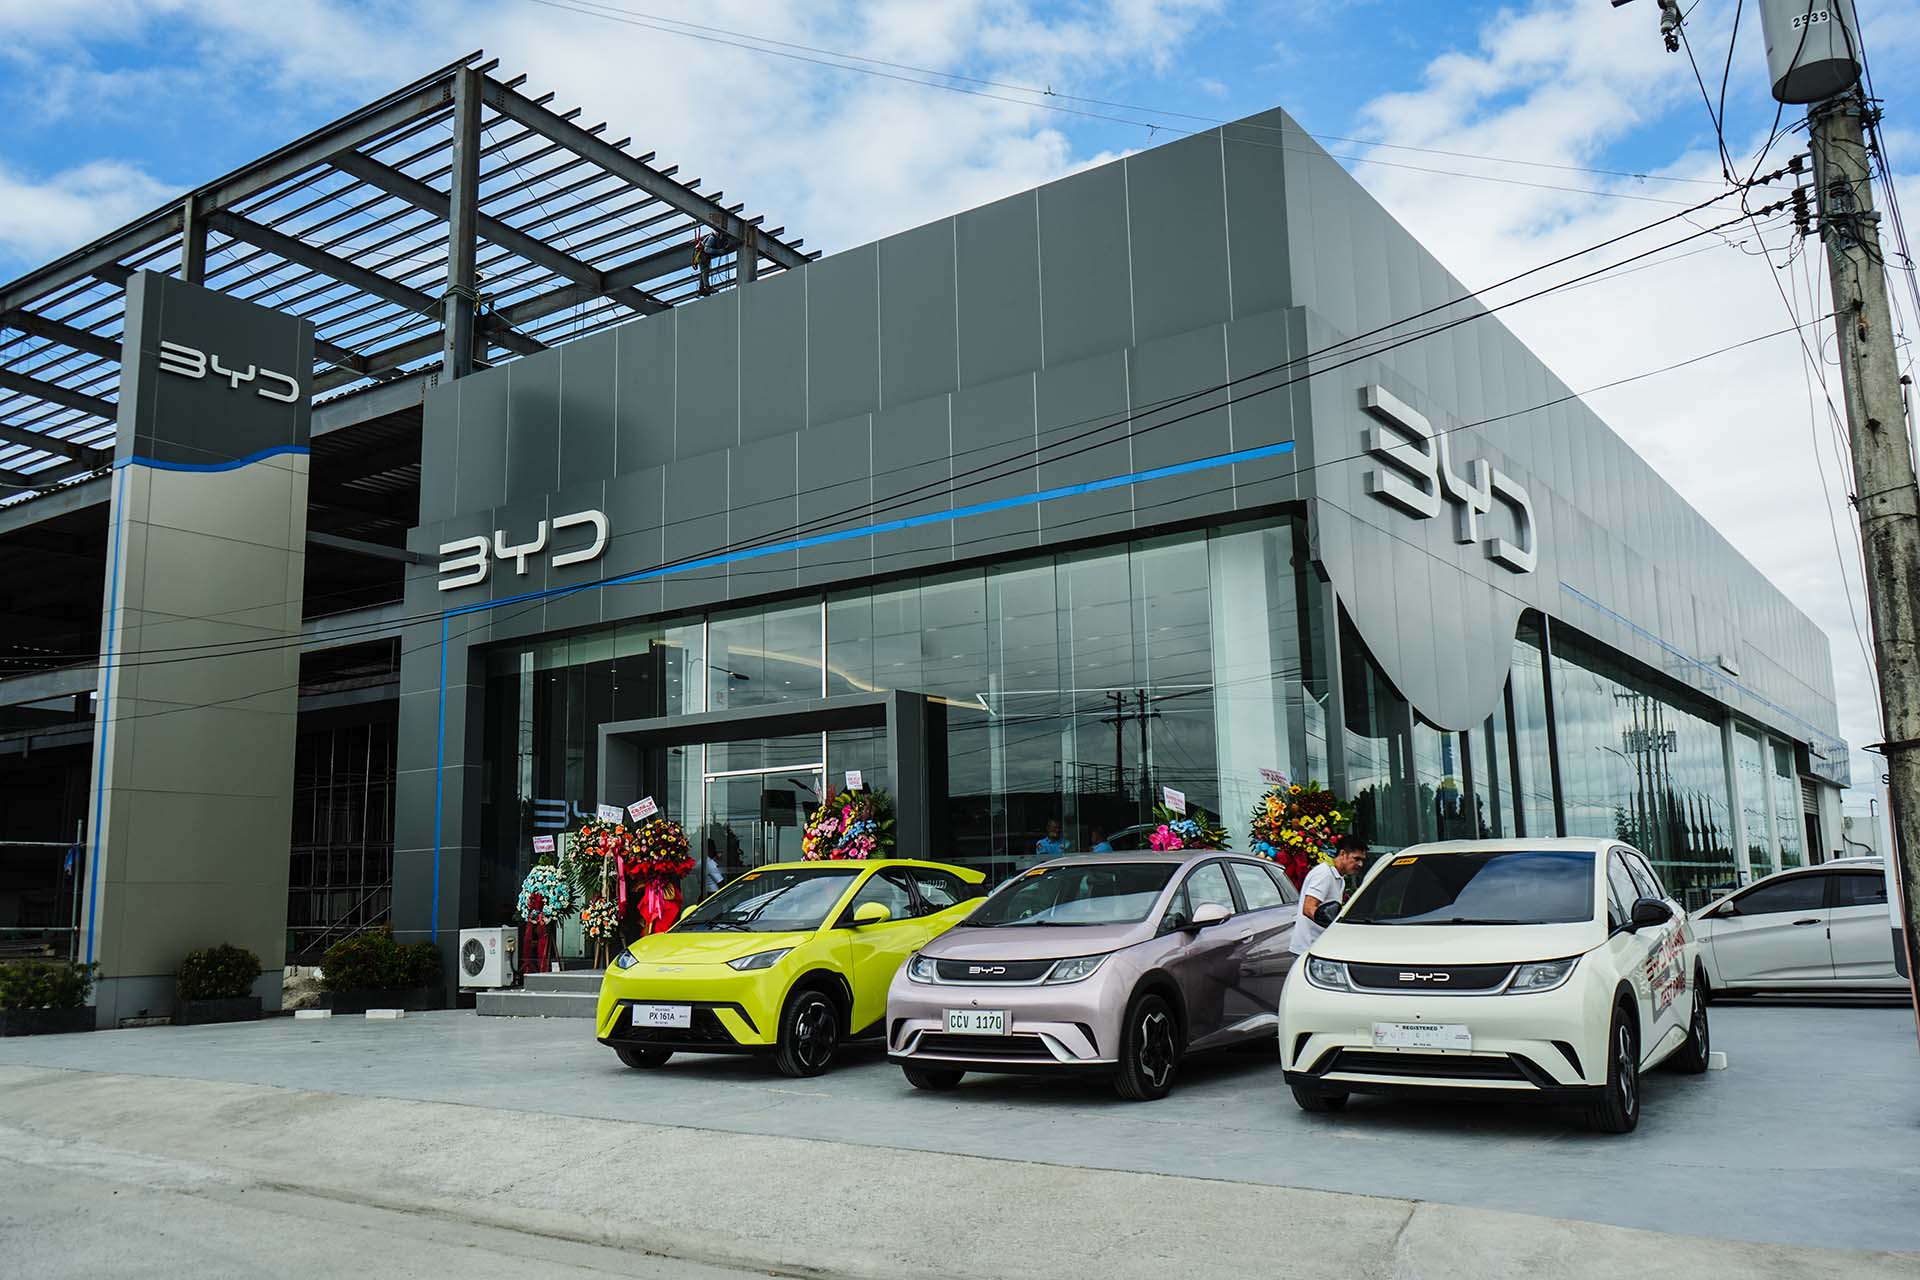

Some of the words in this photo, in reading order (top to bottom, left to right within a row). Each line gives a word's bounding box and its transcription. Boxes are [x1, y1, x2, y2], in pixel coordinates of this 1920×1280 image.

[1793, 11, 1828, 28] 2939
[158, 340, 300, 404] BYD
[1359, 384, 1538, 574] BYD
[438, 509, 610, 592] BYD
[968, 966, 1006, 974] BYD
[1399, 971, 1450, 982] BYD
[649, 1011, 658, 1020] PX
[660, 1012, 675, 1021] 161A
[950, 1015, 969, 1029] CCV
[975, 1016, 1002, 1030] 1170
